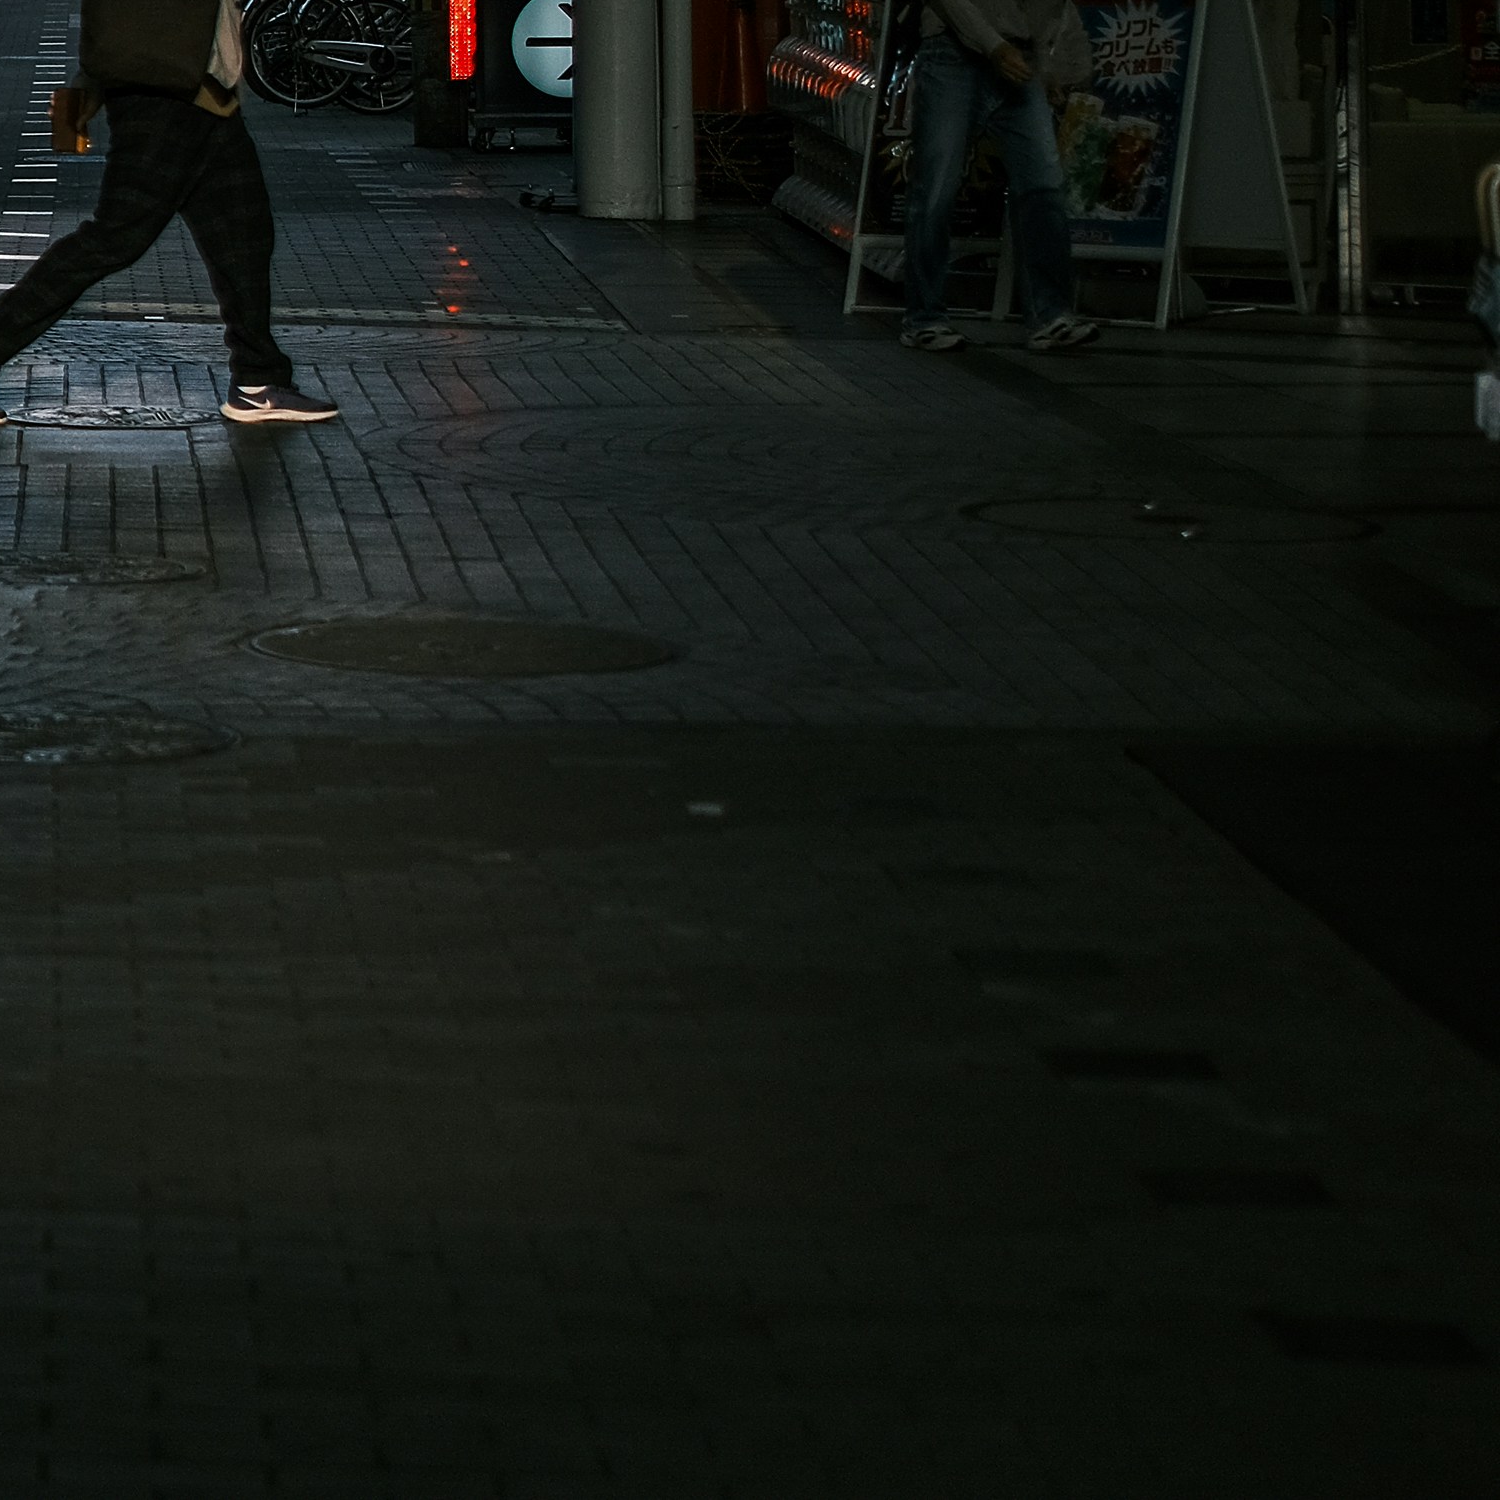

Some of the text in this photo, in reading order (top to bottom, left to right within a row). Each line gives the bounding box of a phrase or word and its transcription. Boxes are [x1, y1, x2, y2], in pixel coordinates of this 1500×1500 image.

[1116, 17, 1160, 38] ソフト
[1099, 40, 1174, 59] クリームも
